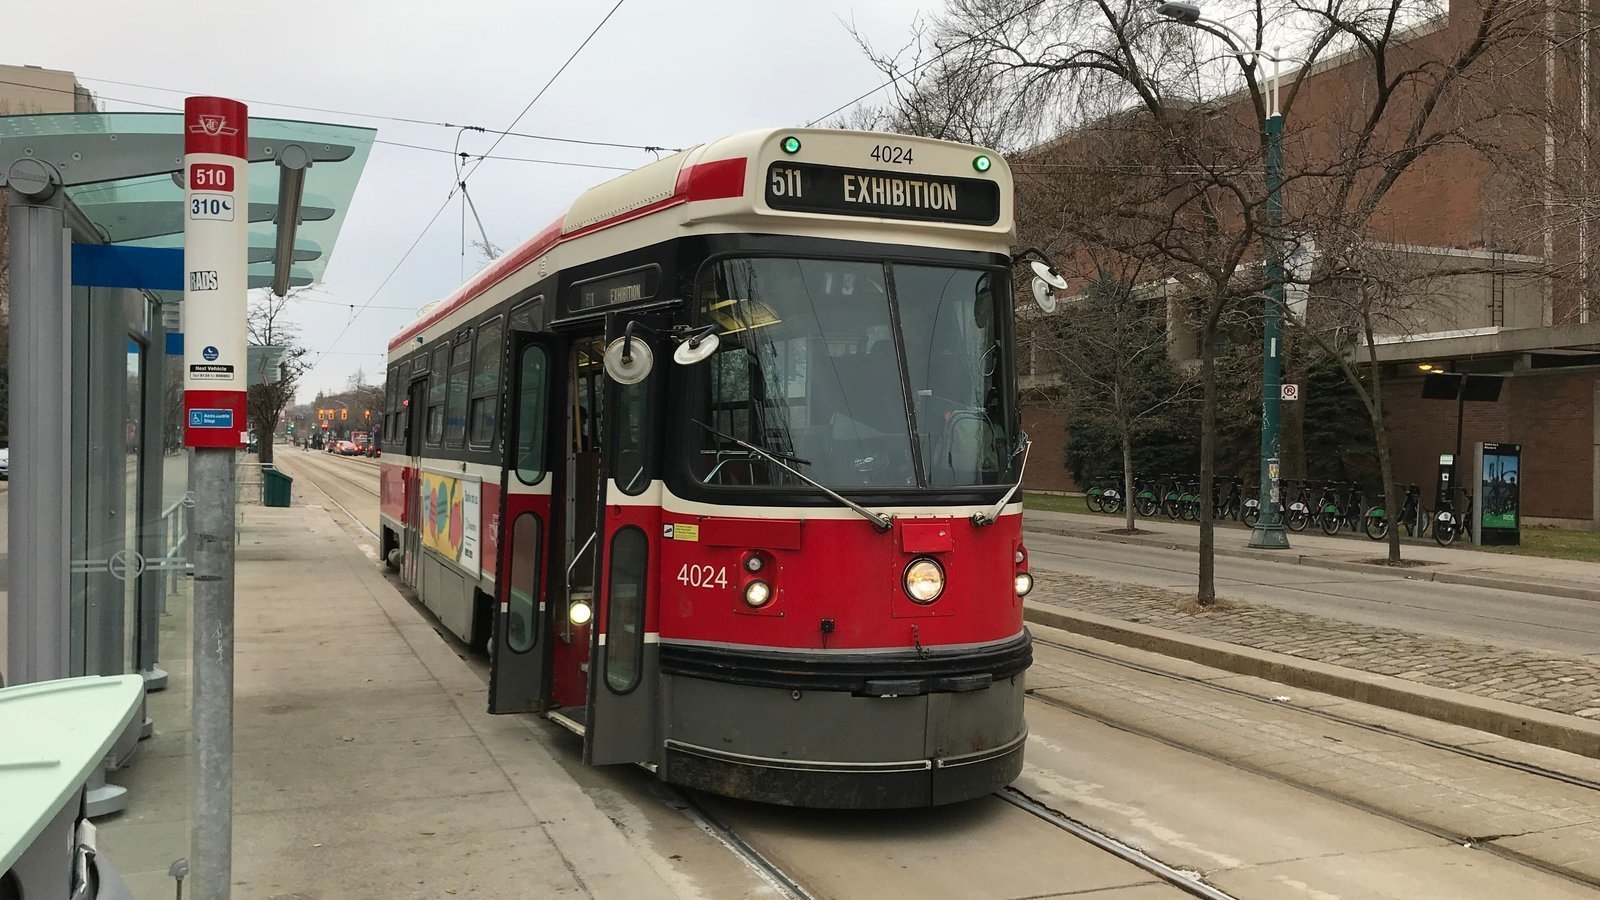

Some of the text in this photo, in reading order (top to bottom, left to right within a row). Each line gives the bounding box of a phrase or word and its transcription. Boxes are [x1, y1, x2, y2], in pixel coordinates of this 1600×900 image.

[870, 144, 914, 165] 4024
[196, 169, 226, 186] 510
[771, 167, 957, 211] 511 EXHIBITION
[192, 198, 220, 215] 310
[610, 284, 641, 304] EXHIBITION
[677, 563, 728, 589] 4024
